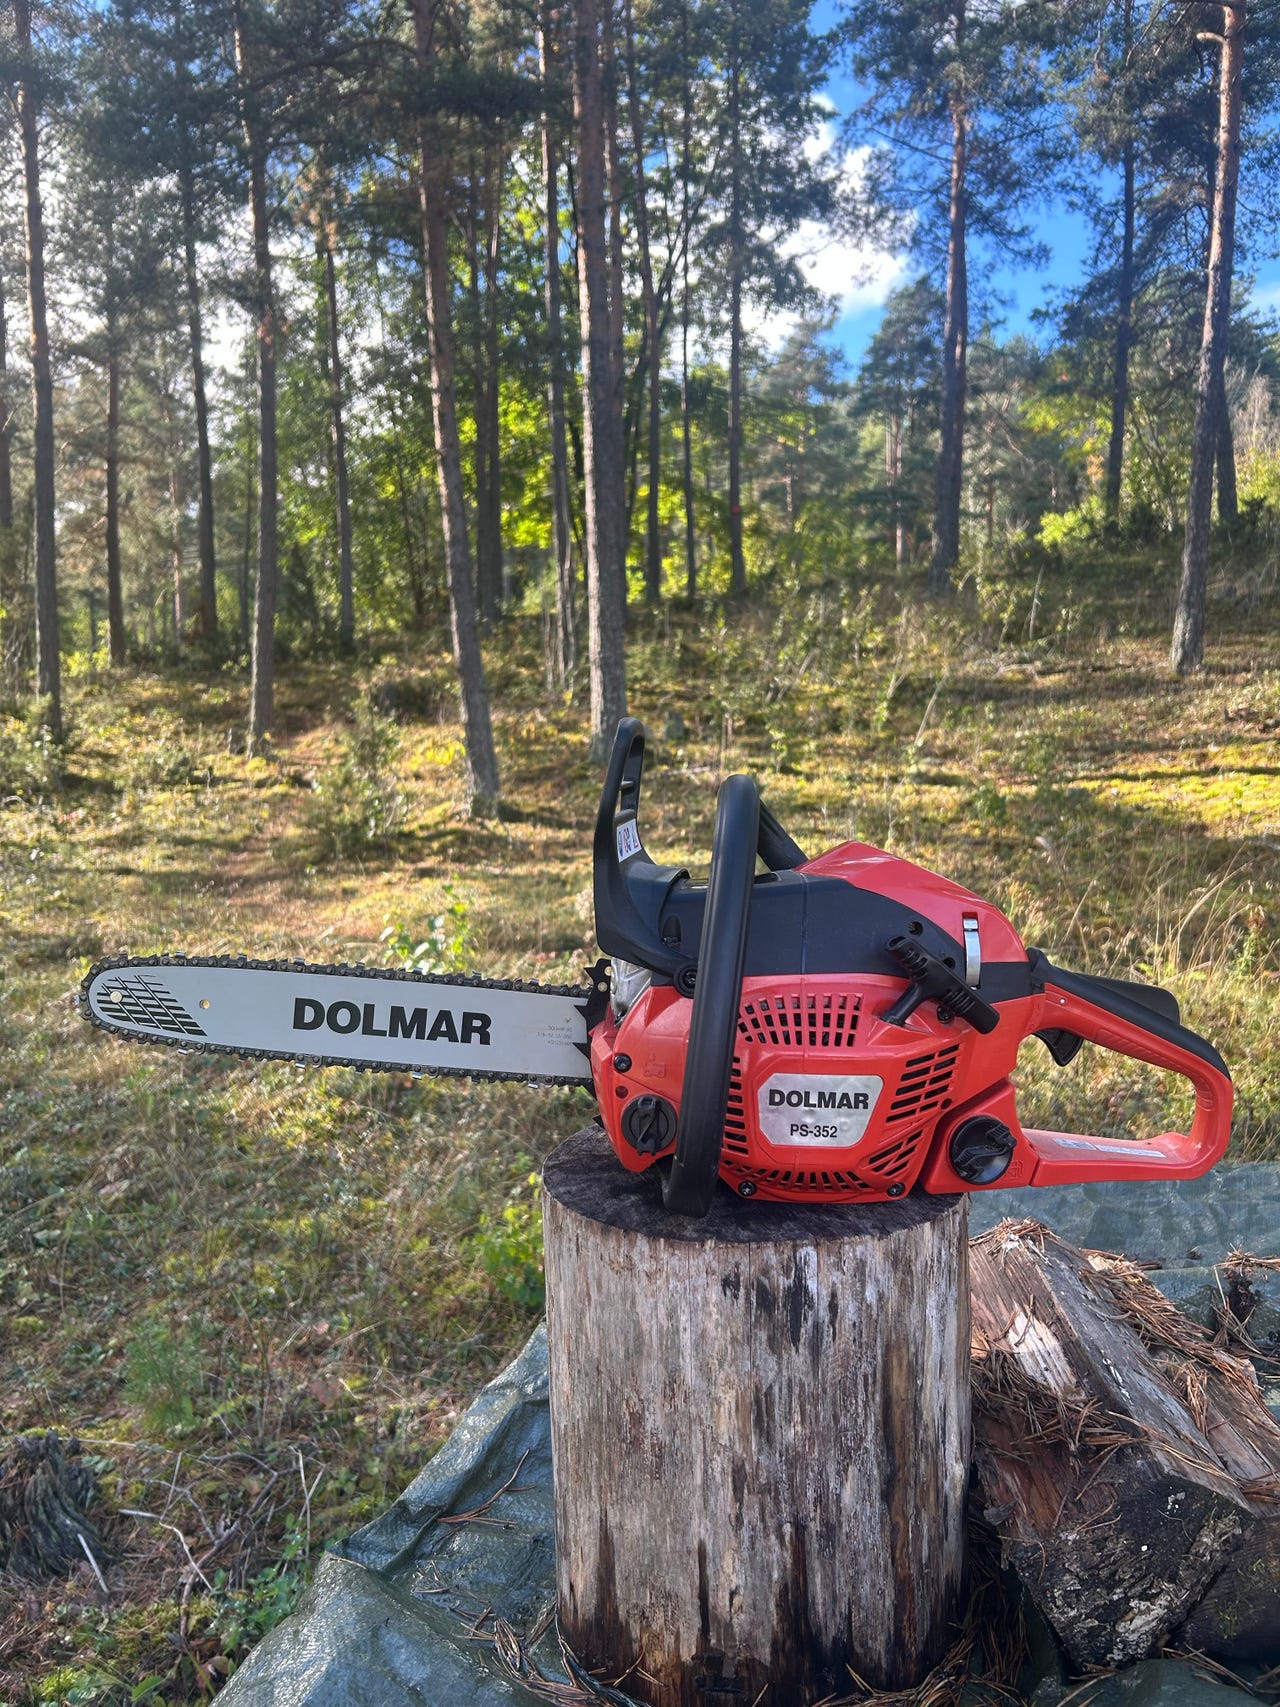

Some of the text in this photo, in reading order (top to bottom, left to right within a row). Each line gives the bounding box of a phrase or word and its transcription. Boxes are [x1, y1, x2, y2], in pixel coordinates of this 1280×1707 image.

[293, 997, 492, 1045] DOLMAR
[768, 1089, 869, 1109] DOLMAR
[790, 1123, 838, 1138] PS-352
